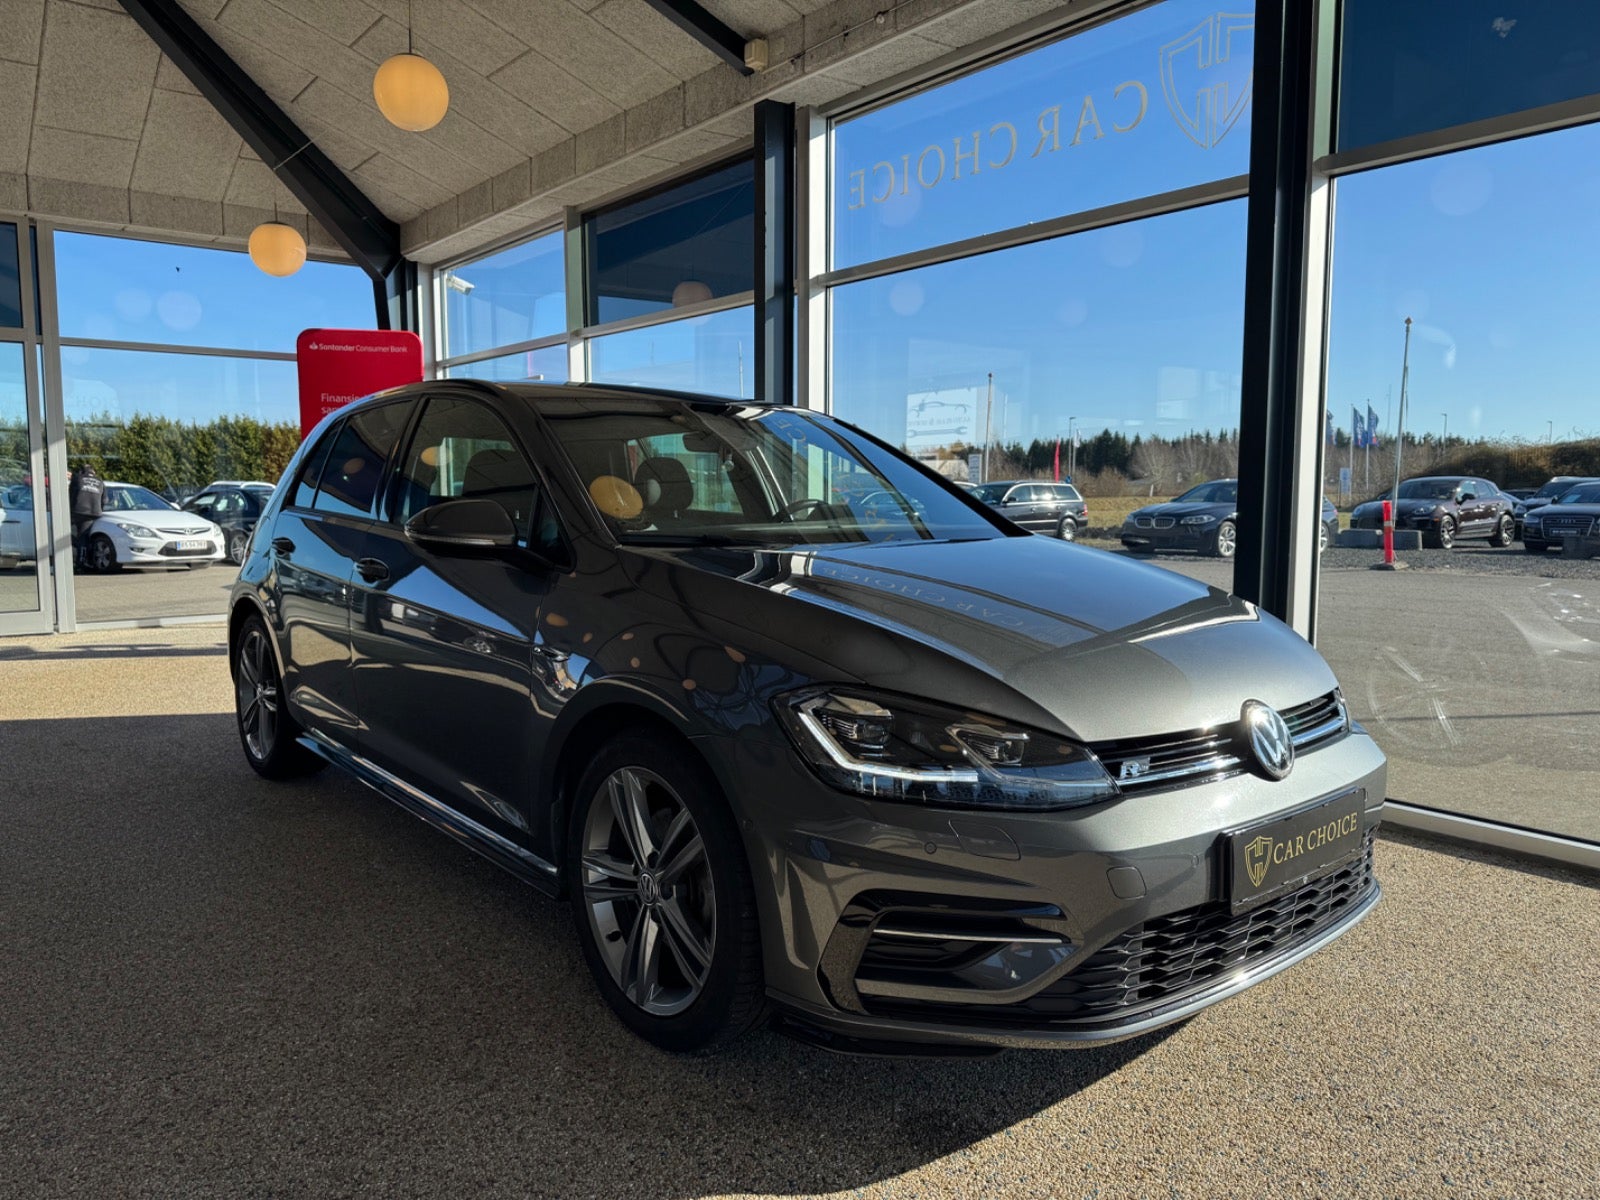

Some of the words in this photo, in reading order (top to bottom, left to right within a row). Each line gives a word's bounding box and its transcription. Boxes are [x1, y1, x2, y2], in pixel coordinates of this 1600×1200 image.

[319, 343, 355, 352] Santander
[355, 345, 389, 353] Consumer
[1273, 836, 1304, 865] CAR
[1307, 812, 1358, 851] CHOICE
